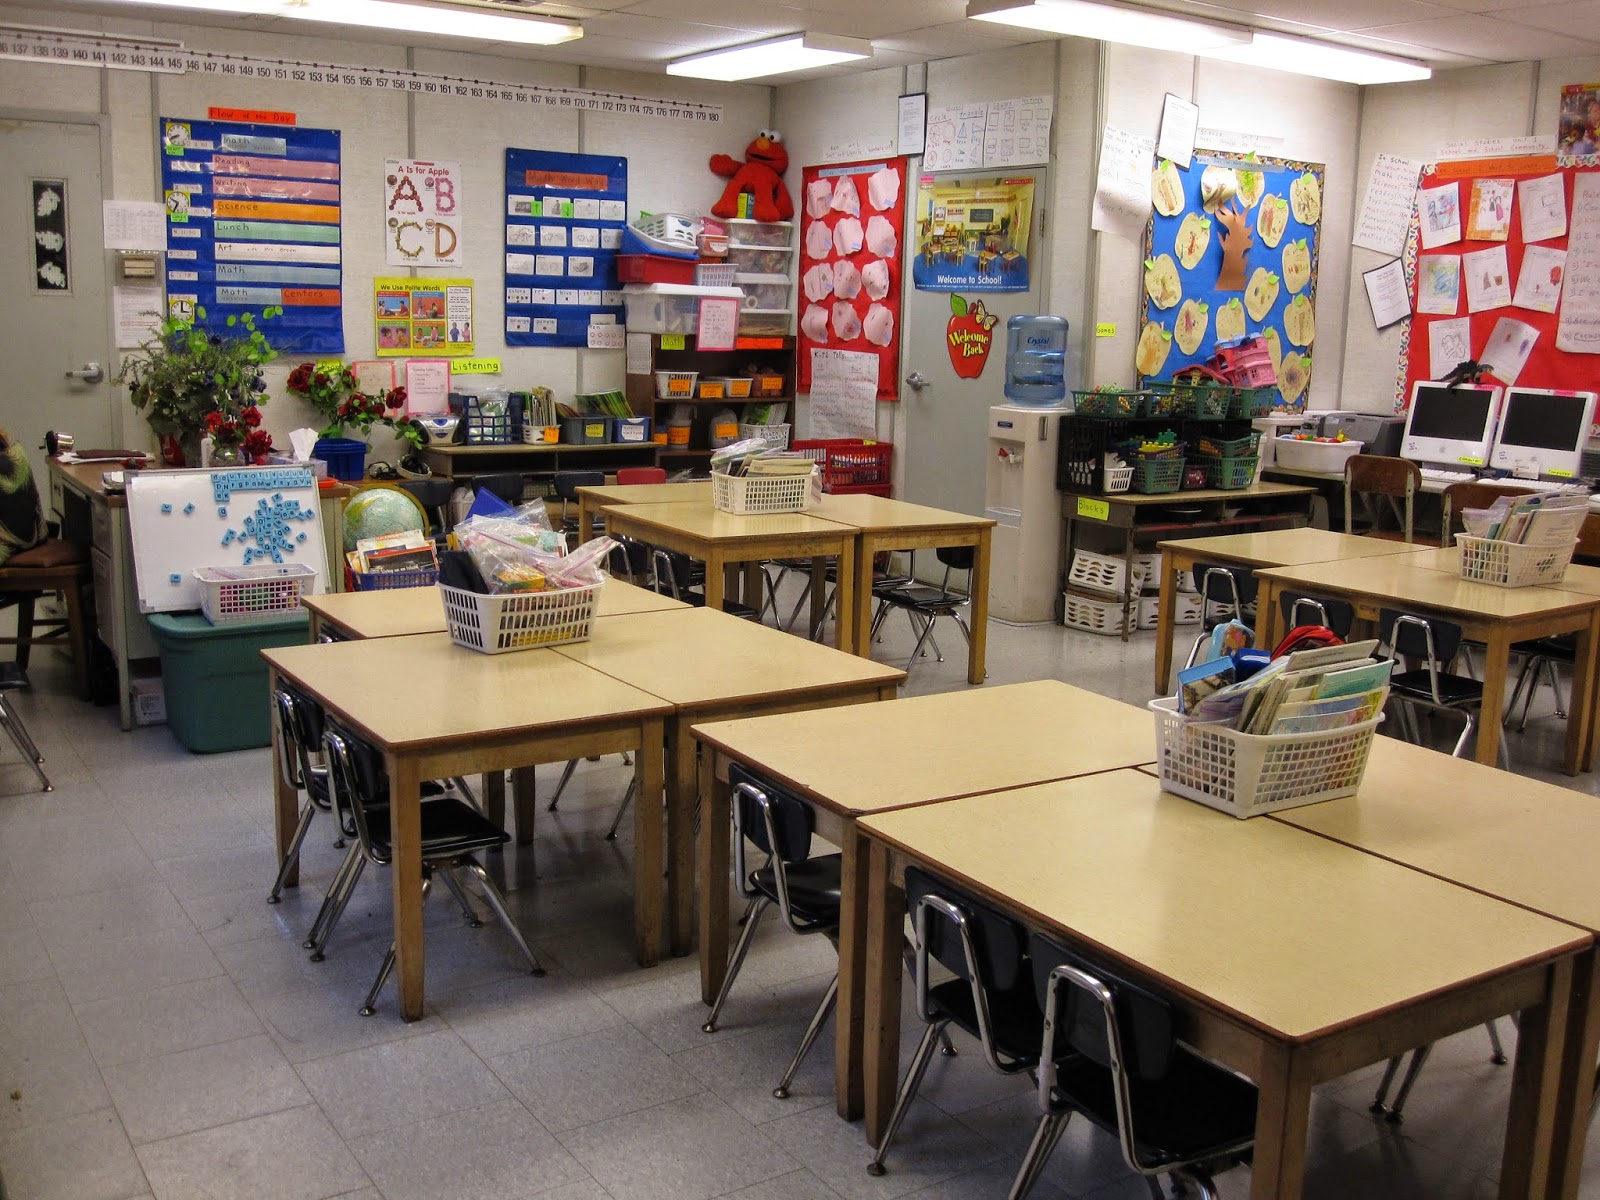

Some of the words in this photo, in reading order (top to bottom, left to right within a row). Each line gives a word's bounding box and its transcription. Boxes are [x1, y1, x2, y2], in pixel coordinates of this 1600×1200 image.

[12, 43, 28, 54] 137
[33, 45, 48, 56] 138
[53, 47, 68, 58] 139
[73, 49, 88, 60] 140
[92, 51, 106, 61] 141
[112, 52, 126, 63] 142
[131, 55, 145, 65] 143
[150, 57, 164, 66] 144
[168, 58, 182, 68] 145
[186, 60, 199, 70] 146
[203, 62, 217, 72] 147
[222, 64, 235, 74] 148
[239, 65, 253, 75] 149
[257, 67, 270, 77] 150
[275, 69, 287, 79] 151
[292, 71, 305, 80] 152
[309, 72, 322, 82] 153
[326, 74, 339, 83] 154
[343, 75, 355, 84] 155
[359, 77, 372, 86] 156
[376, 78, 388, 87] 157
[392, 80, 405, 89] 158
[408, 81, 421, 90] 159
[425, 83, 436, 92] 160
[440, 84, 451, 94] 161
[456, 86, 467, 95] 162
[471, 88, 482, 97] 163
[486, 90, 497, 99] 164
[501, 91, 512, 100] 165
[516, 93, 527, 102] 166
[530, 95, 541, 103] 167
[545, 96, 556, 106] 168
[559, 97, 570, 106] 169
[574, 98, 585, 107] 170
[588, 100, 598, 109] 171
[602, 101, 613, 110] 172
[616, 103, 626, 112] 173
[629, 104, 640, 113] 174
[643, 106, 653, 115] 175
[656, 107, 666, 116] 176
[670, 108, 680, 118] 177
[683, 110, 693, 119] 178
[696, 111, 706, 120] 179
[709, 112, 719, 122] 180
[210, 108, 233, 118] Flow
[273, 113, 291, 123] Day
[215, 156, 250, 167] Reading
[428, 168, 449, 176] Apple
[218, 201, 258, 210] Science
[435, 222, 456, 258] D
[218, 266, 245, 274] Math
[938, 275, 967, 284] Welcome
[969, 276, 975, 284] to
[978, 275, 1002, 284] School!
[284, 290, 323, 298] Centers
[948, 329, 989, 346] Welcome
[1027, 336, 1050, 346] Crystal
[963, 342, 984, 357] Back
[452, 361, 499, 371] Listening
[1078, 500, 1104, 514] Blocks
